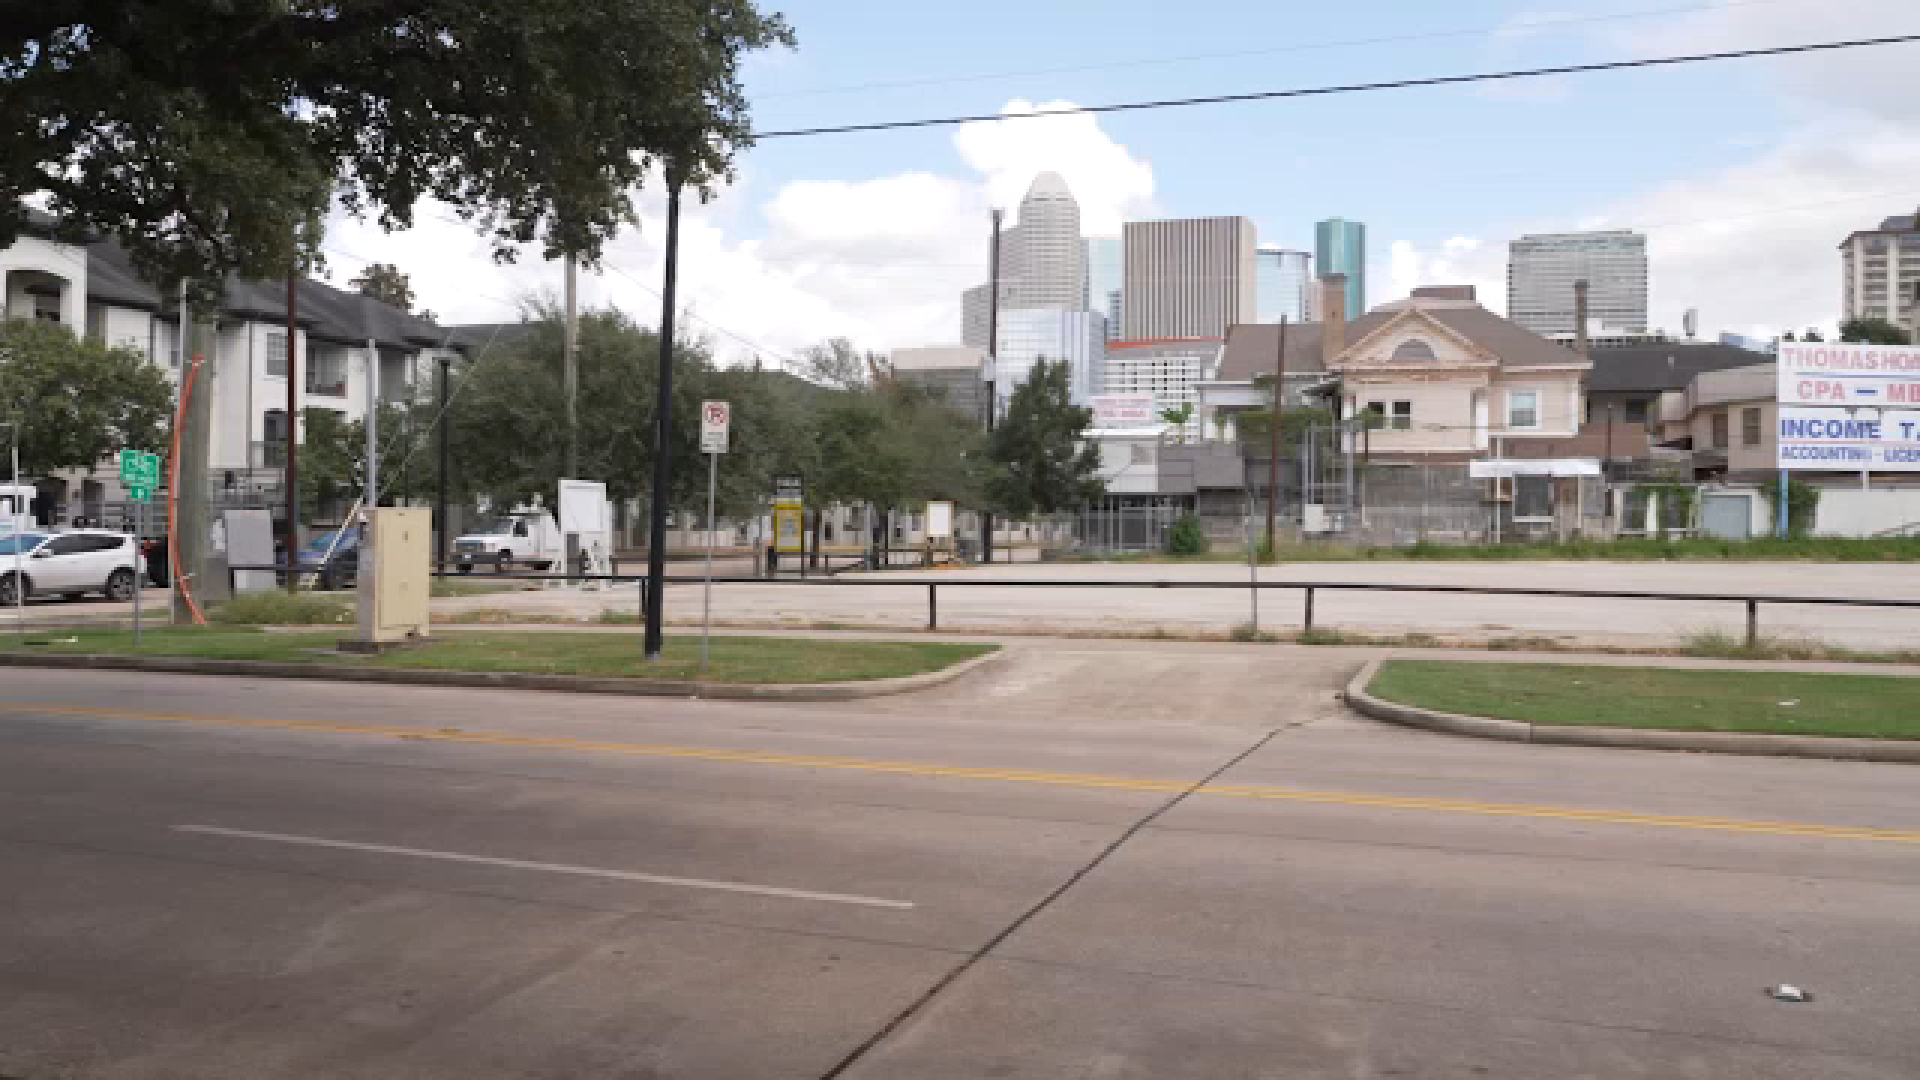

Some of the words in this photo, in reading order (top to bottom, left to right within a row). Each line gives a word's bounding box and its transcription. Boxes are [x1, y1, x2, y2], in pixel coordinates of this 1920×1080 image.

[1782, 348, 1878, 370] THOMAS
[1797, 380, 1846, 400] CPA
[1781, 419, 1882, 439] INCOME
[1898, 421, 1920, 441] T
